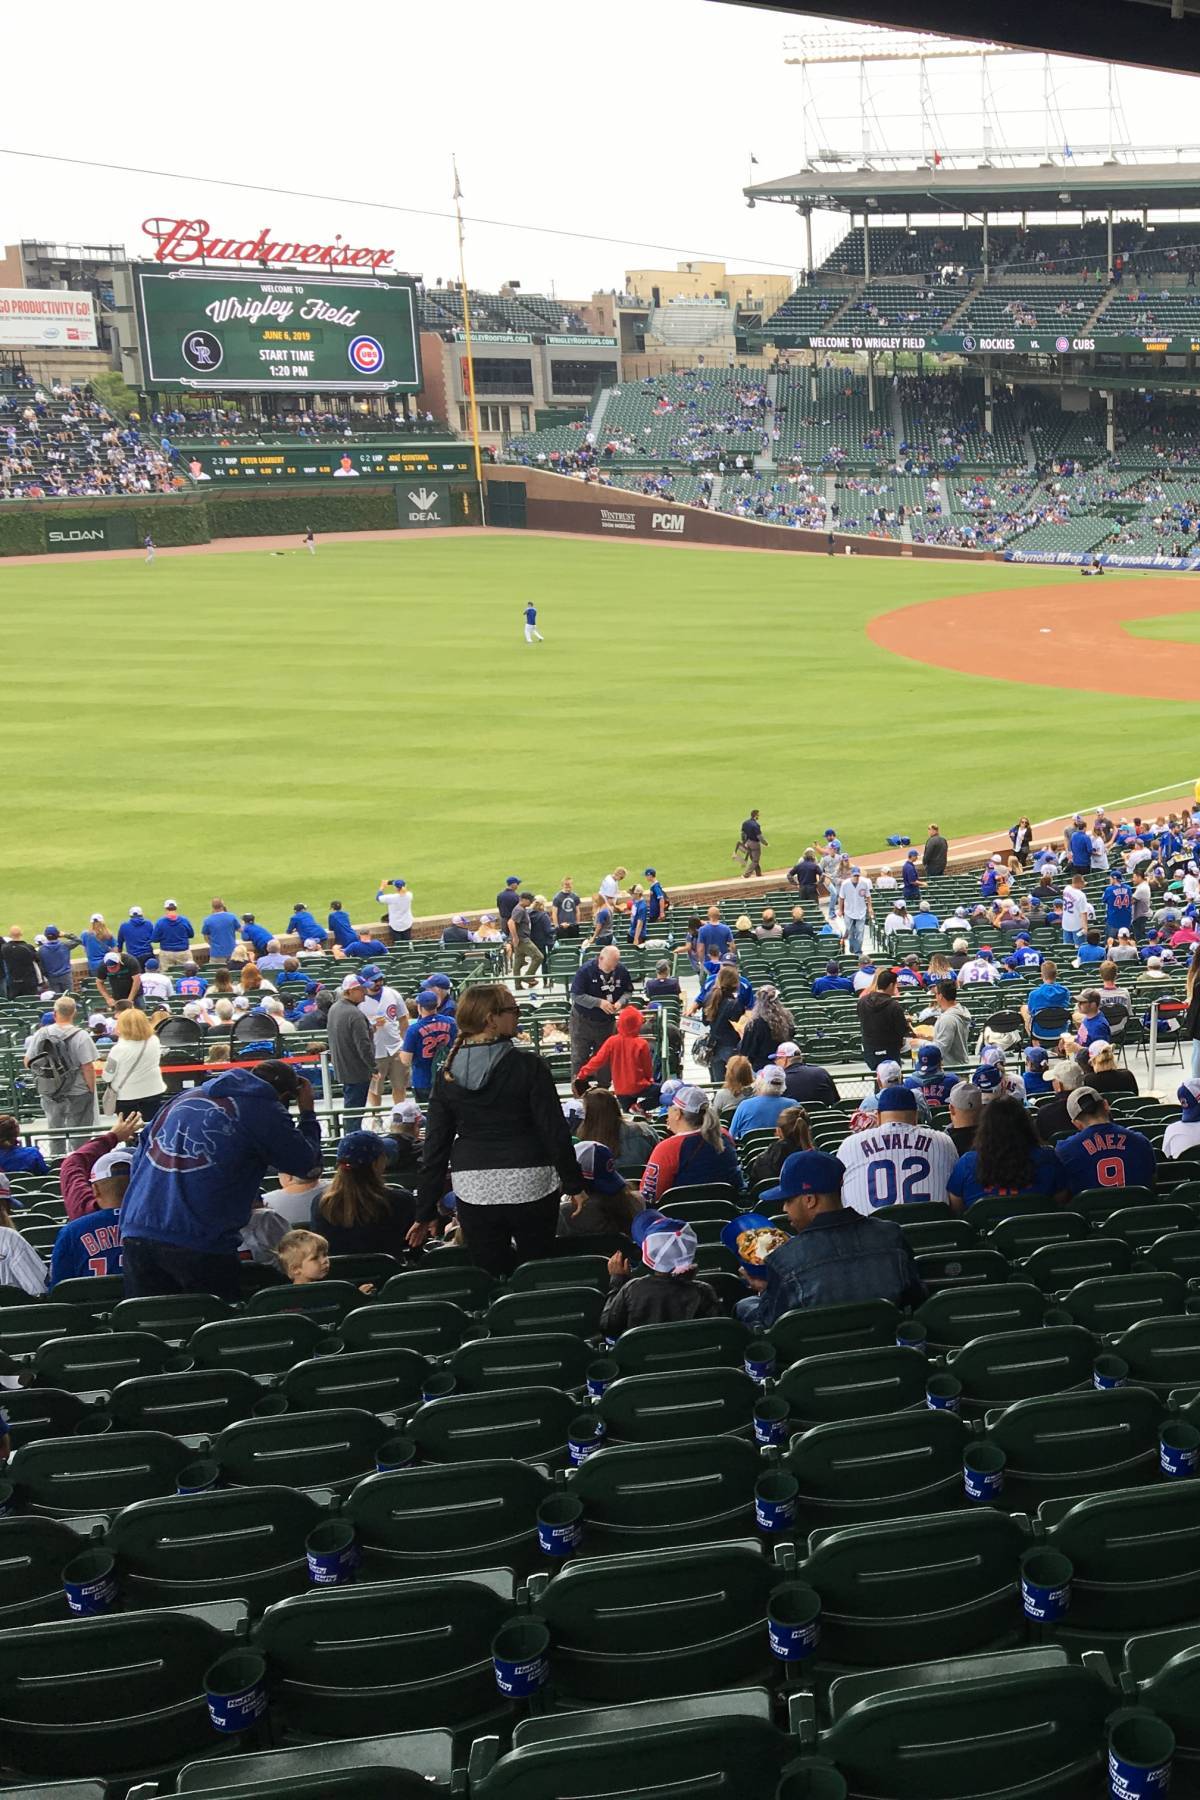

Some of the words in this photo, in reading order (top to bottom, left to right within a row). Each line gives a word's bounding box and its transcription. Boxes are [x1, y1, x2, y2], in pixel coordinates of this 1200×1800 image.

[142, 217, 395, 268] Budweiser
[260, 284, 292, 294] WELCOME
[294, 286, 304, 295] TO
[12, 301, 73, 315] PRODUCTIVITY
[205, 295, 293, 323] Wrigley
[300, 298, 360, 327] Field
[262, 330, 282, 340] JUNE
[283, 331, 290, 341] 6,
[292, 331, 311, 341] 2019
[809, 337, 849, 348] WELCOME
[852, 337, 862, 347] TO
[864, 337, 900, 348] WRIGLEY
[903, 338, 925, 348] FIELD
[980, 339, 1015, 349] ROCKIES
[1073, 339, 1095, 350] CUBS
[259, 349, 291, 361] START
[292, 350, 315, 361] TIME
[269, 366, 290, 376] 1:20
[293, 366, 308, 377] PM
[409, 512, 440, 520] IDEAL
[652, 513, 685, 530] PCM
[49, 530, 104, 542] SLOAN
[1012, 551, 1056, 563] Reynolds
[1057, 553, 1083, 565] Wrap
[1106, 554, 1152, 566] Reynolds
[1153, 555, 1182, 567] Wrap
[1113, 895, 1129, 908] 44
[970, 968, 989, 982] 34
[860, 1133, 933, 1158] ALVALDI
[867, 1156, 931, 1208] 02
